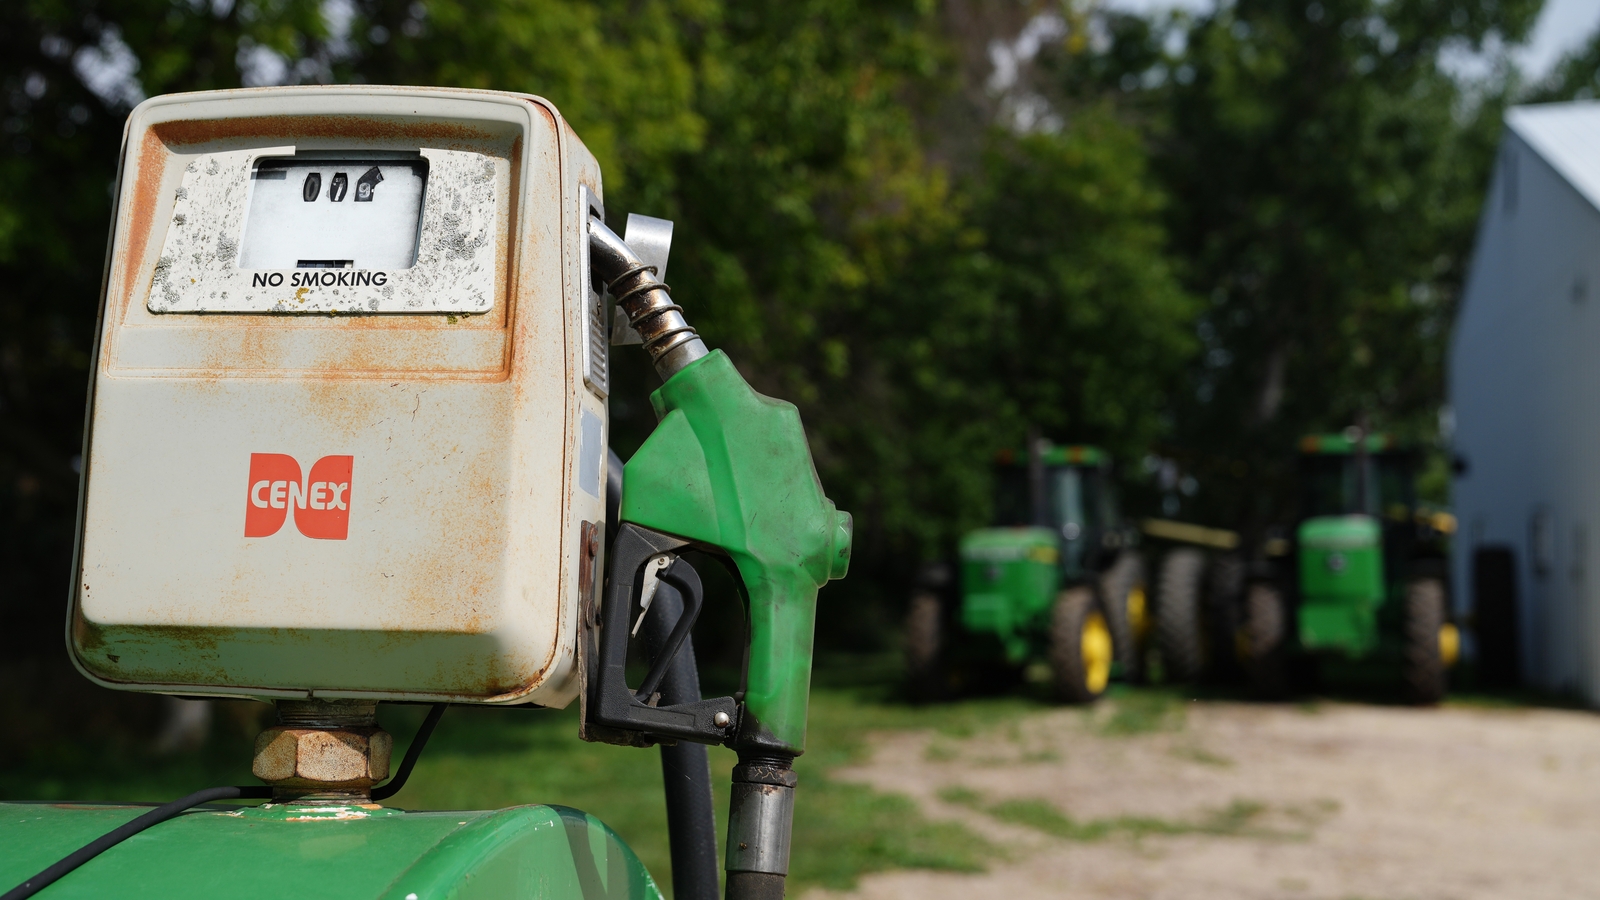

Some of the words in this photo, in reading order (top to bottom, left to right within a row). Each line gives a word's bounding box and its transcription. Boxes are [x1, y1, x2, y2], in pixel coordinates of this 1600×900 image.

[252, 272, 284, 287] NO
[290, 271, 388, 287] SMOKING
[250, 480, 348, 511] CENEX
